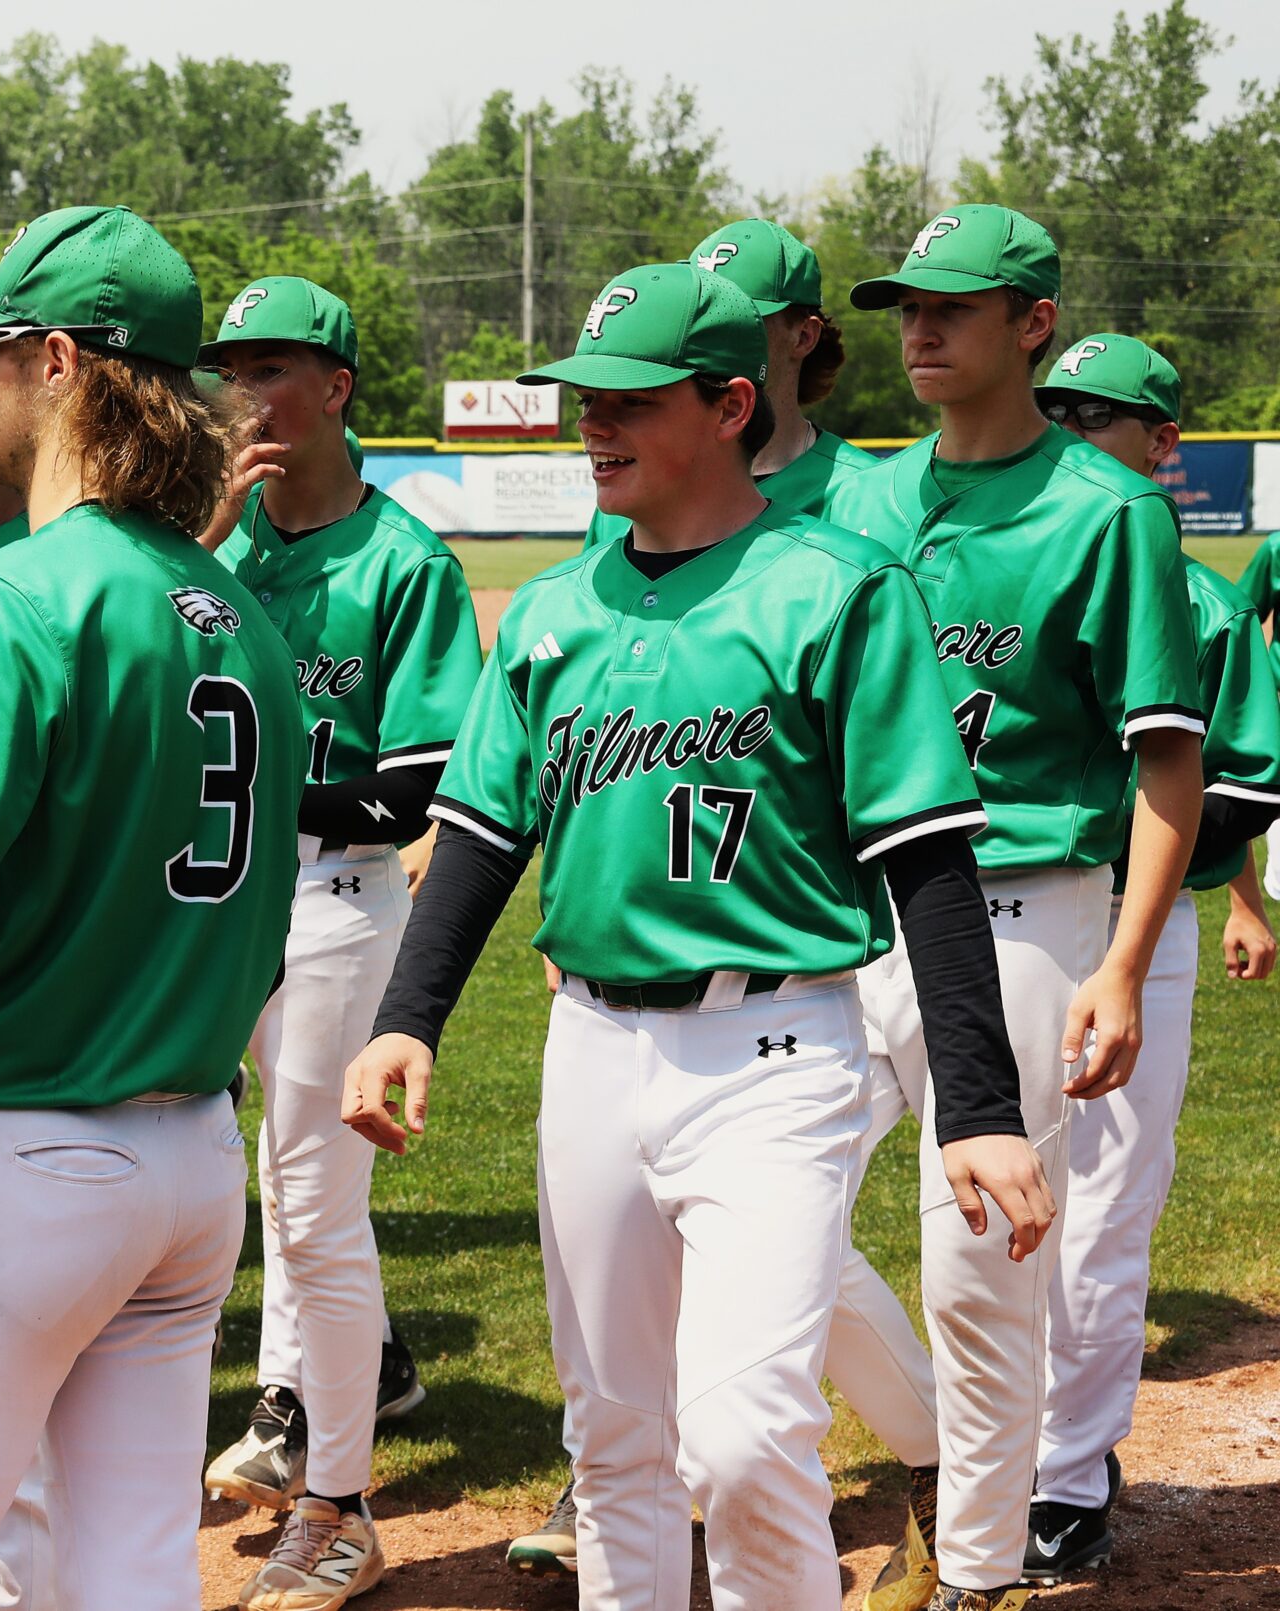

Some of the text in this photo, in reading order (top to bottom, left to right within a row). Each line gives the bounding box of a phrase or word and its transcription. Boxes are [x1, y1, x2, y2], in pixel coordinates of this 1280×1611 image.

[495, 468, 595, 486] ROCHESTE
[165, 673, 261, 904] 3
[538, 703, 774, 815] Filmore
[662, 782, 757, 884] 17
